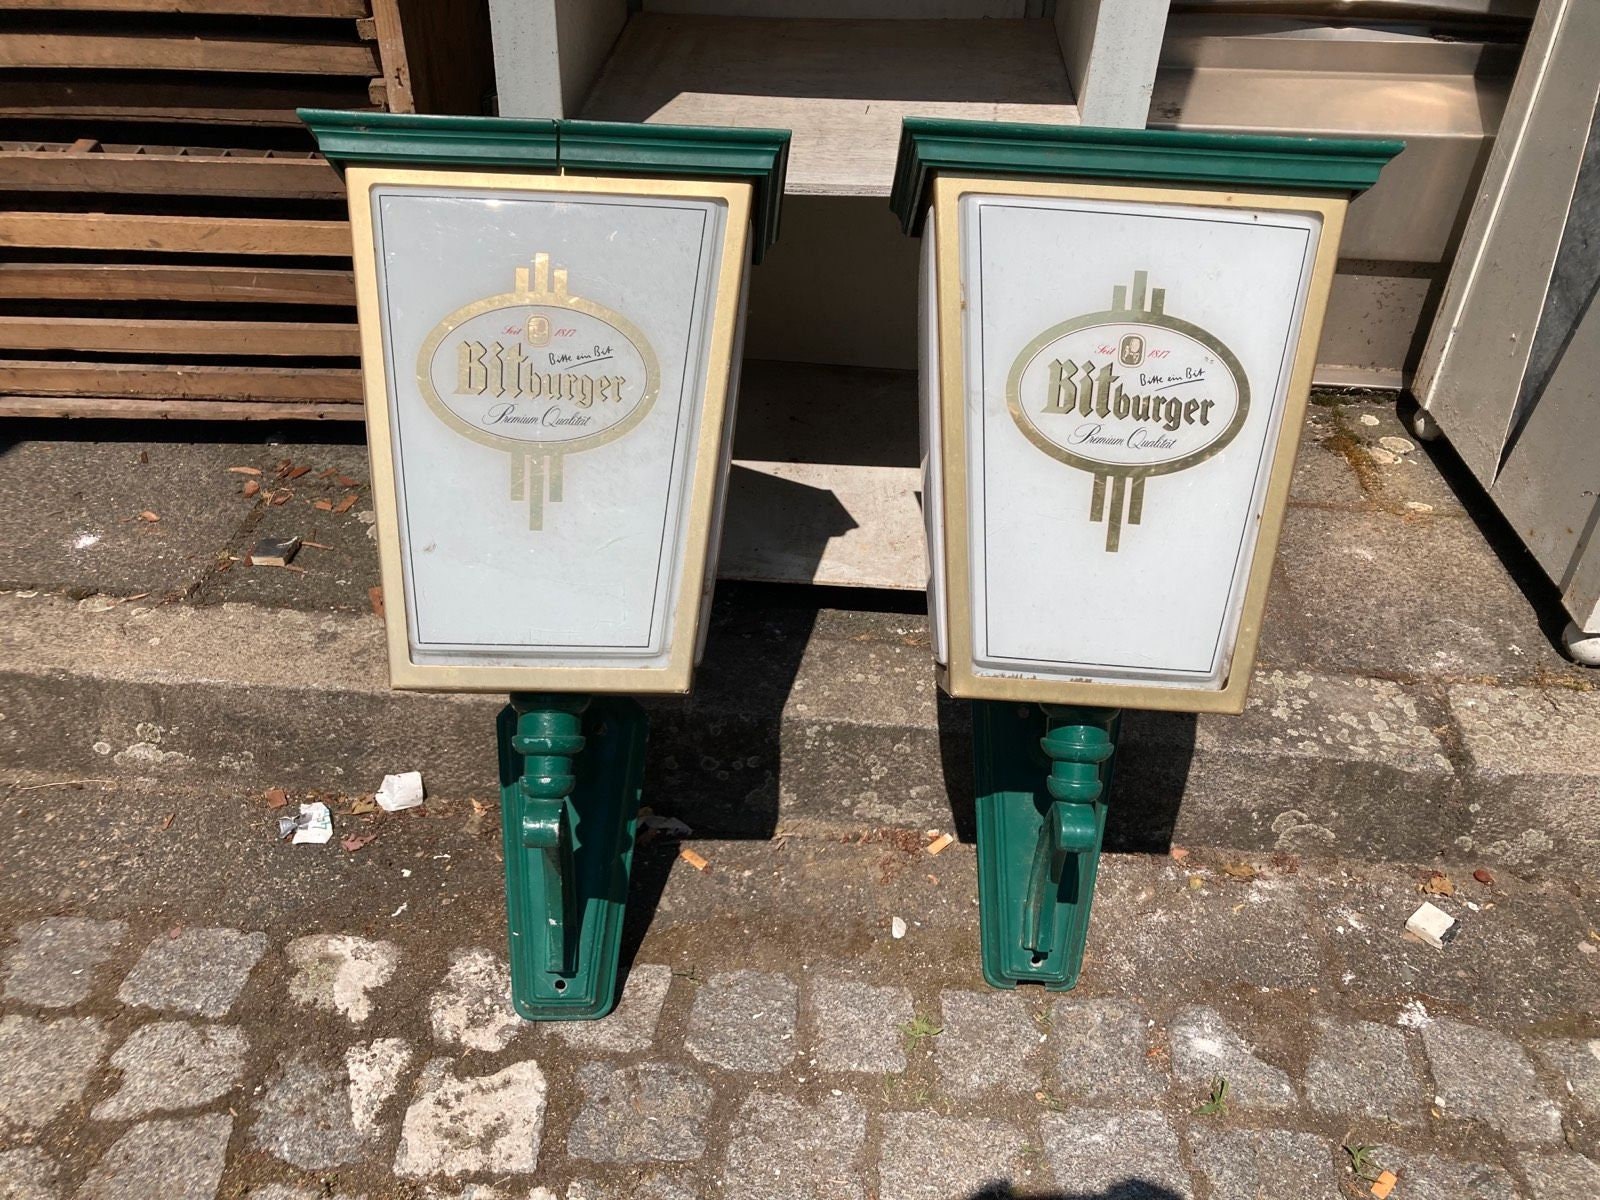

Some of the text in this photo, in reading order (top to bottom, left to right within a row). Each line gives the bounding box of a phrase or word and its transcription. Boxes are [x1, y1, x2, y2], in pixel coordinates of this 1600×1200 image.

[501, 325, 577, 337] Seit 1817
[549, 346, 613, 366] Bitte ein Bit
[1094, 345, 1170, 359] Seit 1817
[453, 340, 626, 409] Bitburger
[1140, 368, 1205, 387] Bitte ein Bit
[1040, 358, 1215, 432] Bitburger
[482, 403, 591, 427] Premium Qualität
[1067, 423, 1178, 449] Premium Qualität
